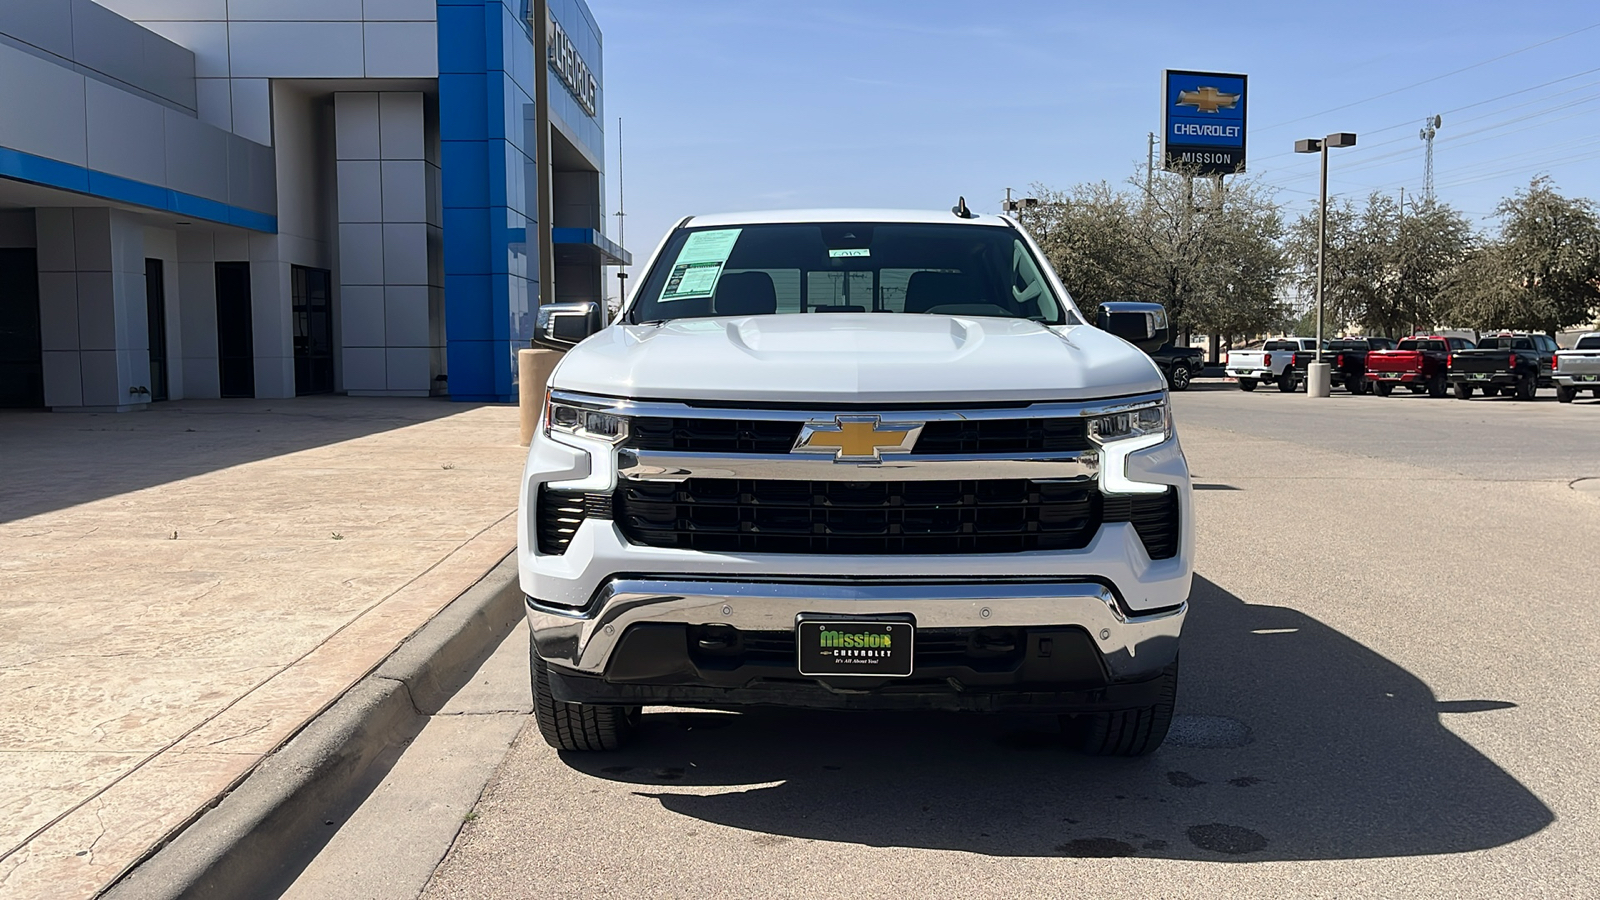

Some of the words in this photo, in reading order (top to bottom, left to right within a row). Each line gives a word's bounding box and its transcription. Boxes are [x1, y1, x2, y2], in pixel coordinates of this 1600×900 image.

[554, 21, 597, 116] CHEVROLET
[1174, 123, 1240, 137] CHEVROLET
[1182, 152, 1231, 164] MISSION
[820, 630, 892, 648] Mission
[833, 649, 892, 657] CHEVROLET
